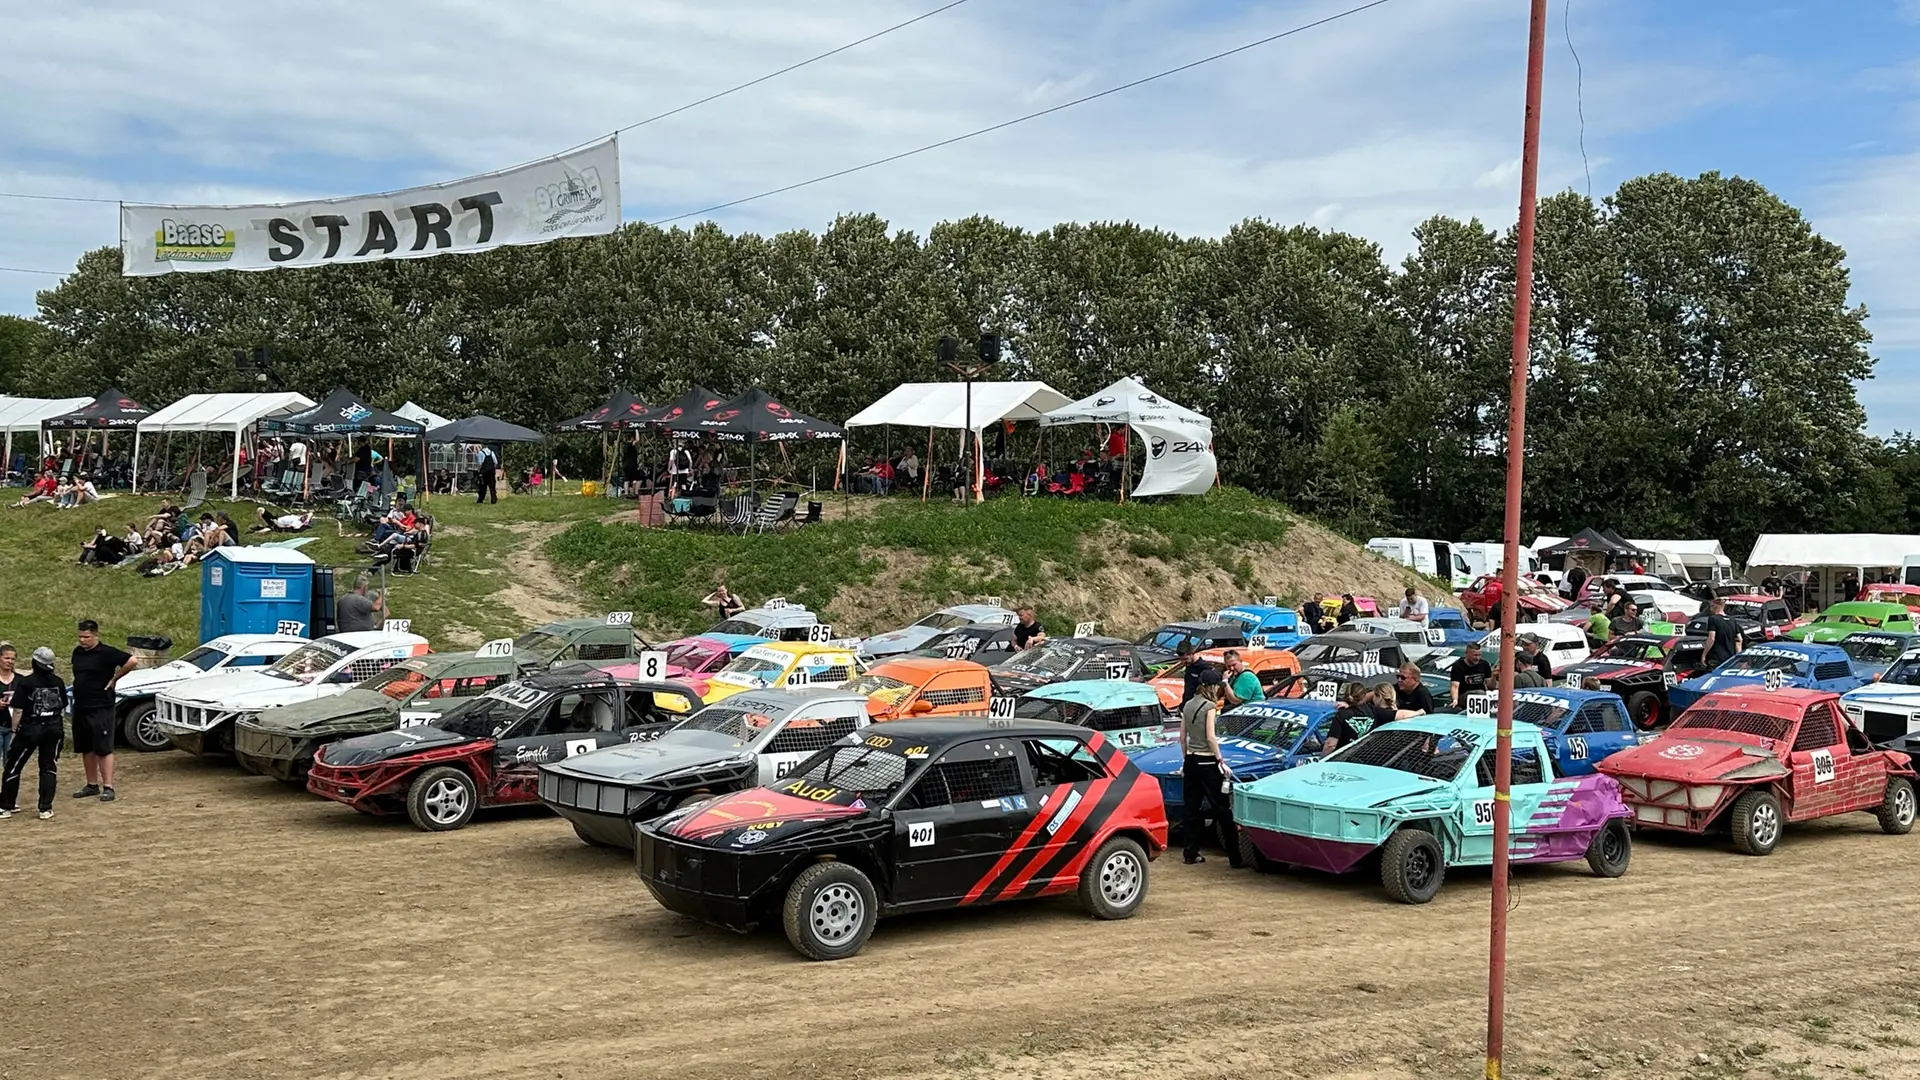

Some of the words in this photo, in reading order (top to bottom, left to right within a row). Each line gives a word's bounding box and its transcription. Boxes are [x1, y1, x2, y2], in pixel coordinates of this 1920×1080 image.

[162, 218, 226, 247] Baase
[268, 191, 503, 263] START
[108, 419, 137, 427] 24MX
[313, 423, 361, 433] sledstore
[375, 424, 419, 433] sledstore
[672, 431, 700, 439] 24MX
[717, 432, 745, 441] 24MX
[769, 431, 799, 440] 24MX
[815, 431, 842, 439] 24MX
[773, 600, 786, 610] 272
[610, 612, 630, 624] 832
[1002, 614, 1013, 625] 731
[1219, 610, 1262, 623] HONDA
[278, 621, 299, 636] 322
[385, 621, 409, 634] 149
[764, 628, 779, 640] 665
[811, 626, 828, 643] 85
[1252, 636, 1265, 646] 558
[1430, 630, 1440, 641] 99
[487, 642, 511, 656] 170
[946, 646, 964, 659] 277
[1744, 648, 1810, 662] HONDA
[813, 656, 825, 666] 85
[1365, 652, 1378, 664] 733
[646, 657, 657, 678] 8
[1106, 664, 1130, 680] 157
[1310, 669, 1348, 680] HONDA
[788, 673, 807, 686] 611
[1568, 674, 1581, 688] 451
[1765, 671, 1781, 689] 905
[1318, 683, 1336, 697] 985
[739, 700, 785, 714] SPORT
[990, 698, 1012, 717] 401
[1468, 697, 1488, 714] 950
[1513, 692, 1570, 709] ONDA
[1230, 704, 1309, 726] HONDA
[1118, 732, 1141, 746] 157
[1447, 728, 1480, 743] 950
[517, 745, 548, 762] Ewald
[904, 746, 928, 756] 401
[1571, 738, 1588, 759] 451
[782, 778, 842, 802] Audi
[911, 827, 933, 843] 401
